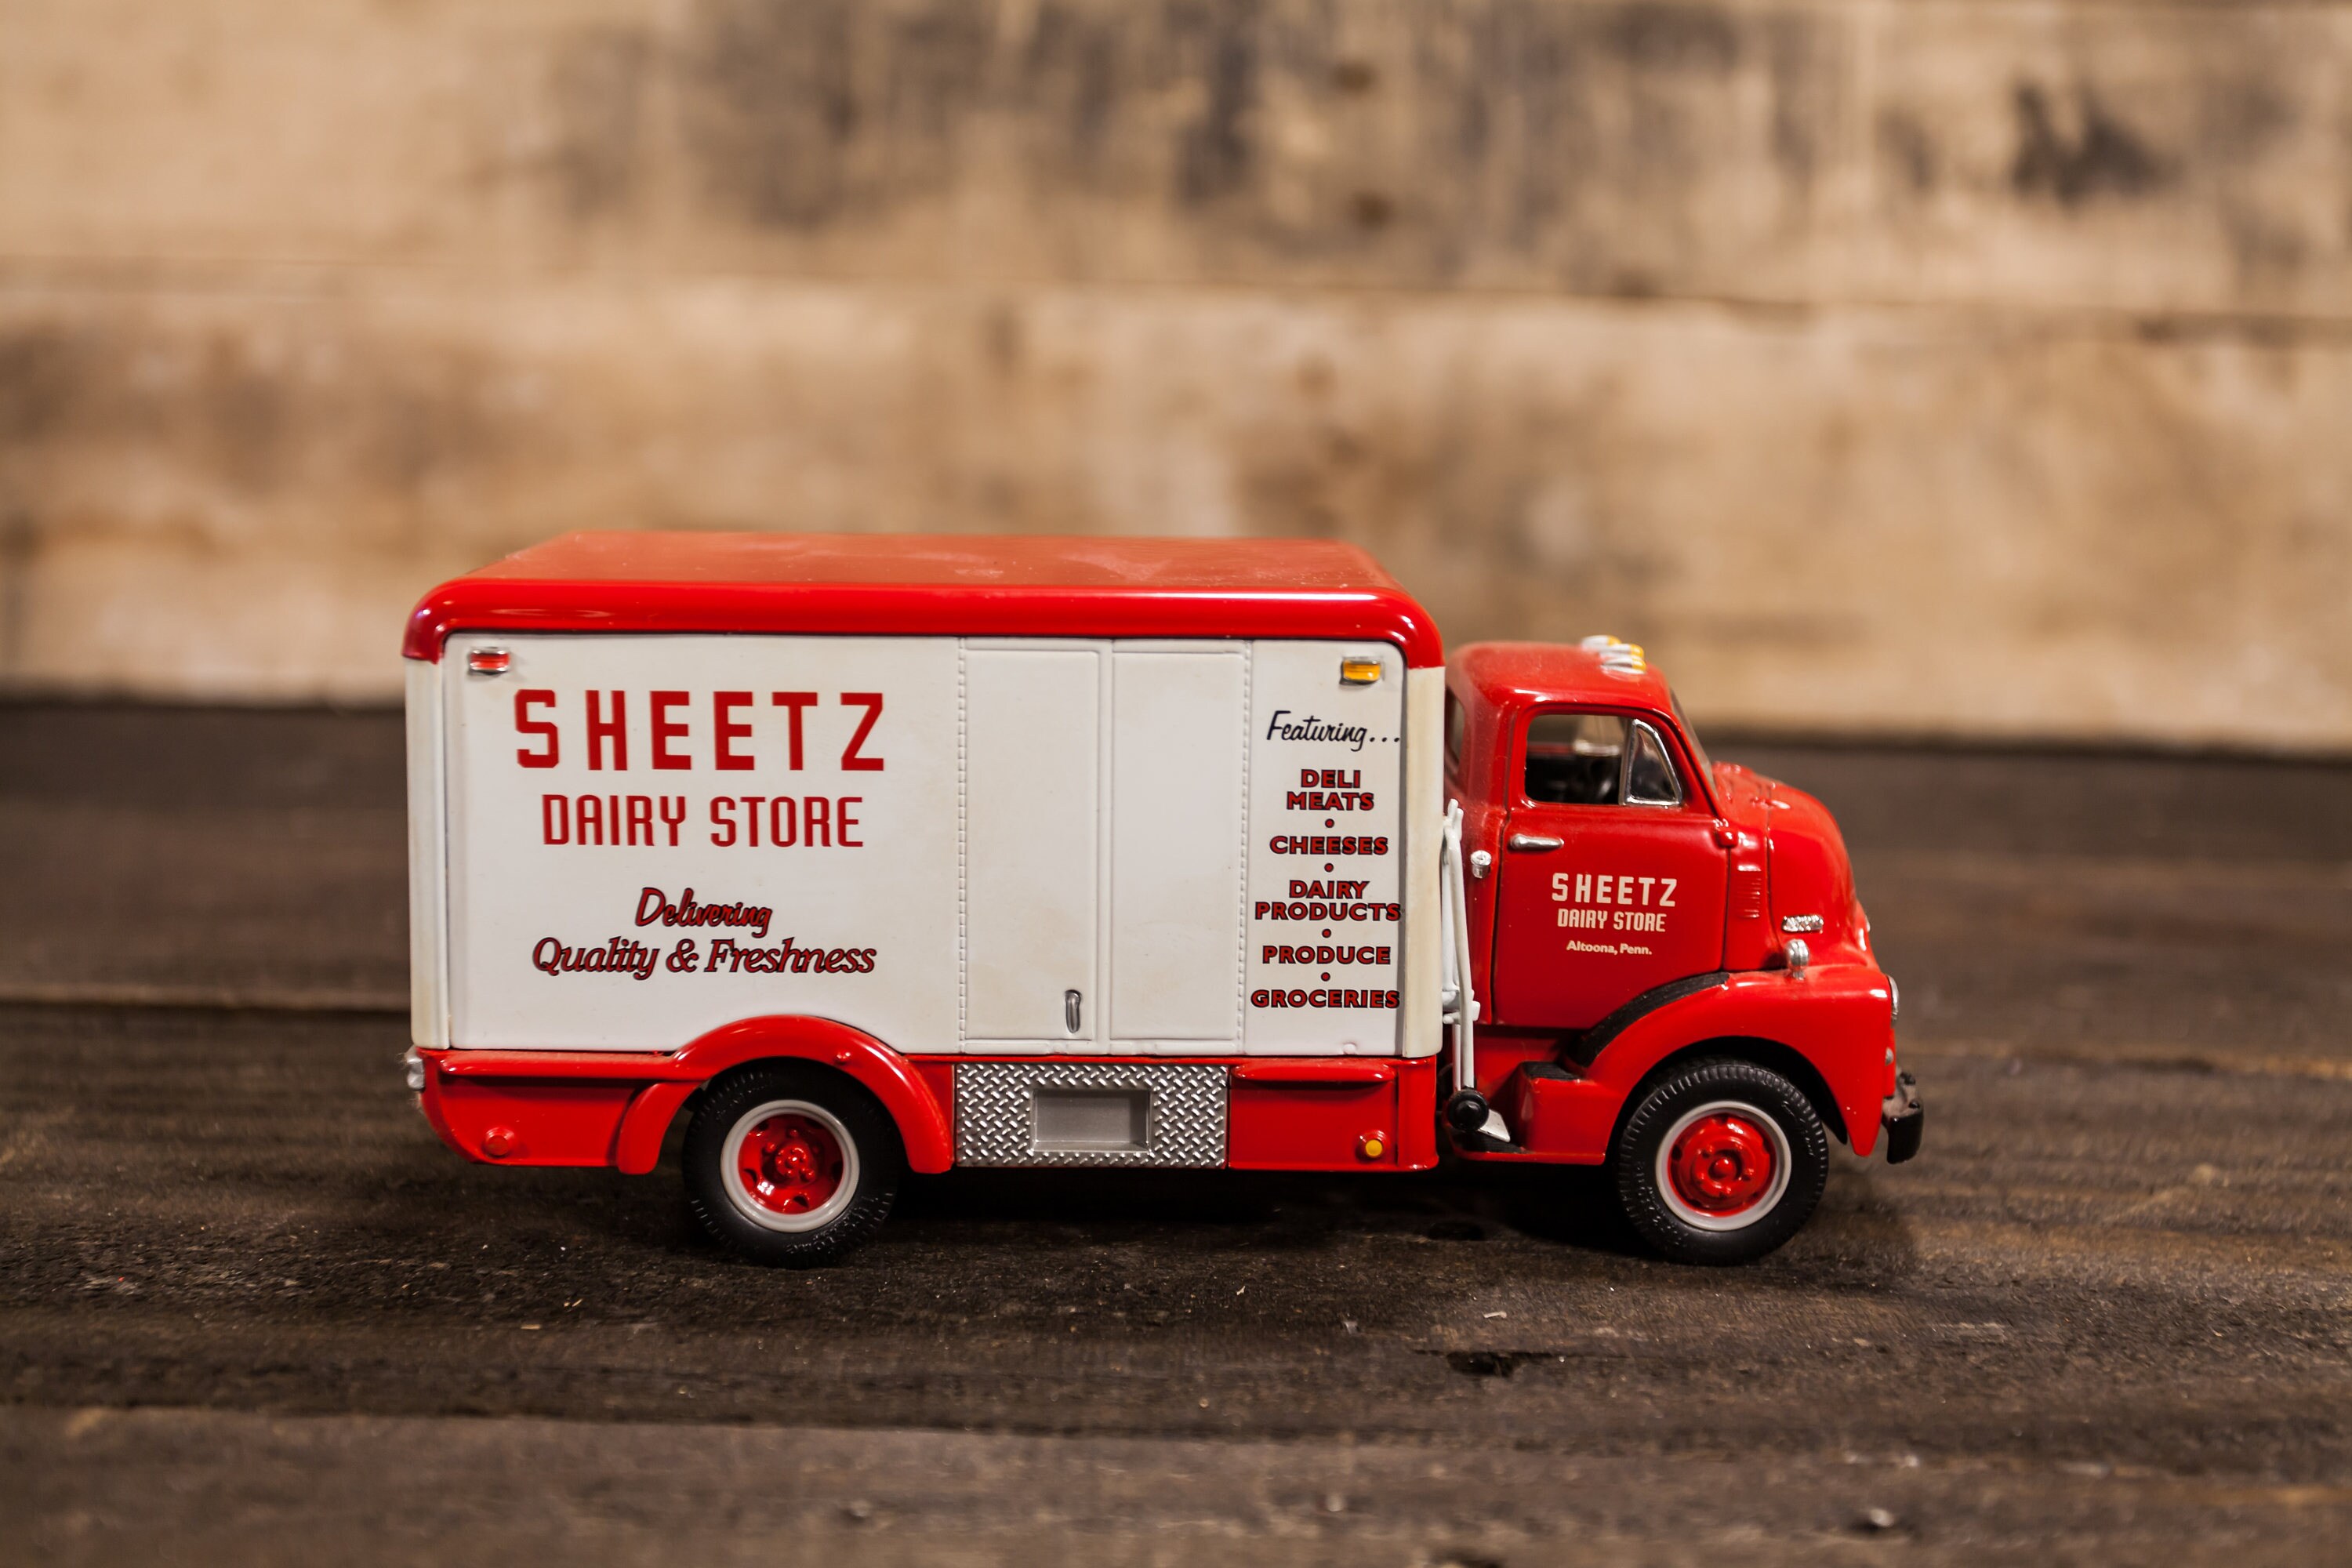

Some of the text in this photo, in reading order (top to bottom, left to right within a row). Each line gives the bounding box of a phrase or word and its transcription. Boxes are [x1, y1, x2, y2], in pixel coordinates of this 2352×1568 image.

[514, 689, 884, 771] SHEETZ
[1301, 769, 1361, 789] DELI
[1287, 791, 1374, 811] MEATS
[542, 793, 864, 848] DAIRY STORE
[1269, 836, 1388, 855] CHEESES
[1289, 880, 1370, 899] DAIRY
[1552, 872, 1678, 907] SHEETZ
[634, 887, 772, 938] Delivering
[1254, 902, 1401, 921] PRODUCTS
[1557, 908, 1667, 932] DAIRY STORE
[532, 936, 877, 980] Quality & Freshness
[1262, 946, 1391, 964] PRODUCE
[1566, 940, 1653, 956] Altoona, Penn.
[1250, 989, 1400, 1009] GROCERIES
